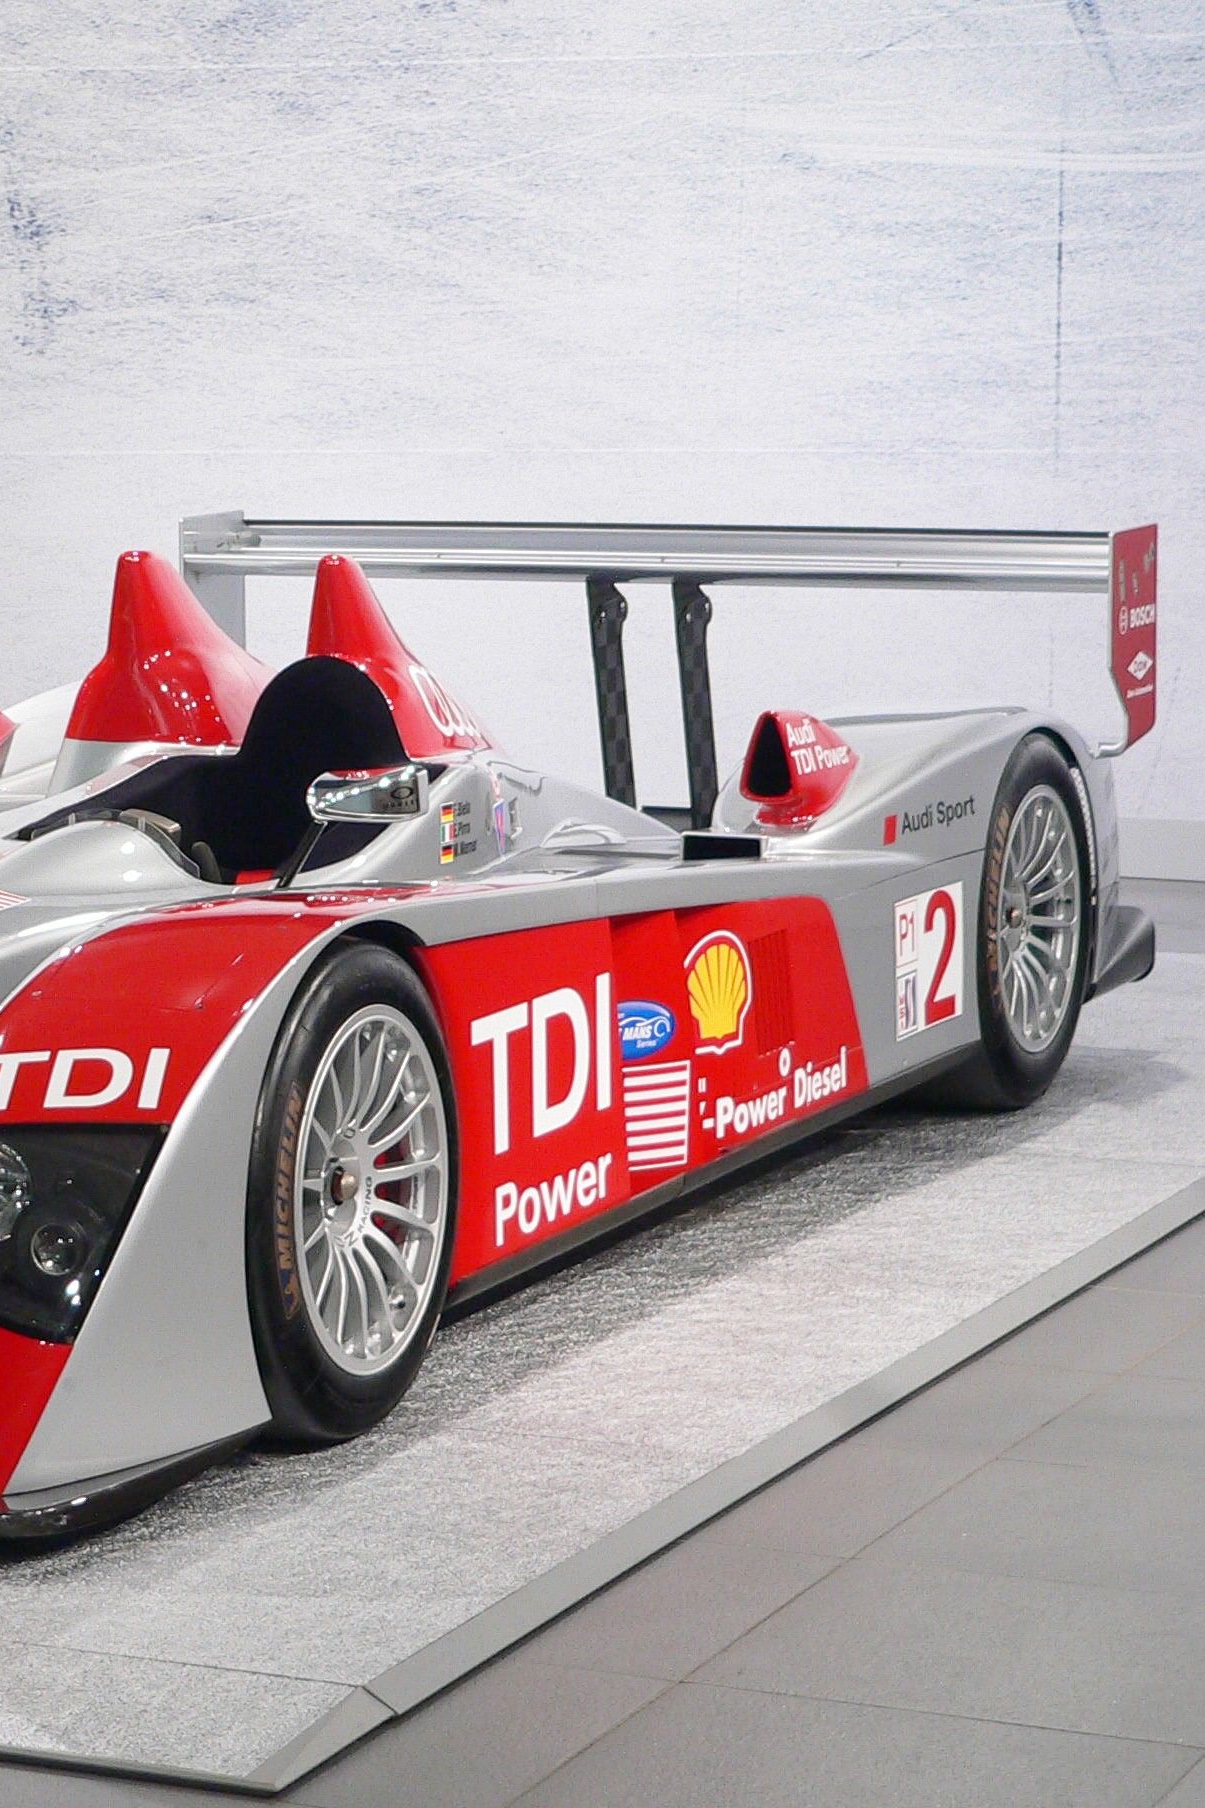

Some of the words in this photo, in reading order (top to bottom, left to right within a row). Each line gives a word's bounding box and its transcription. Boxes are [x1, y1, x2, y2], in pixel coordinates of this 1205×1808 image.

[1130, 604, 1155, 628] BOSCH
[786, 719, 816, 748] Audi
[790, 747, 817, 776] TDI
[901, 806, 933, 835] Audi
[937, 795, 976, 828] Sport
[899, 911, 915, 956] P1
[924, 889, 956, 1026] 2
[471, 971, 612, 1156] TDI
[794, 1046, 847, 1108] Diesel
[276, 1090, 303, 1269] MICHELIN
[495, 1152, 612, 1247] Power
